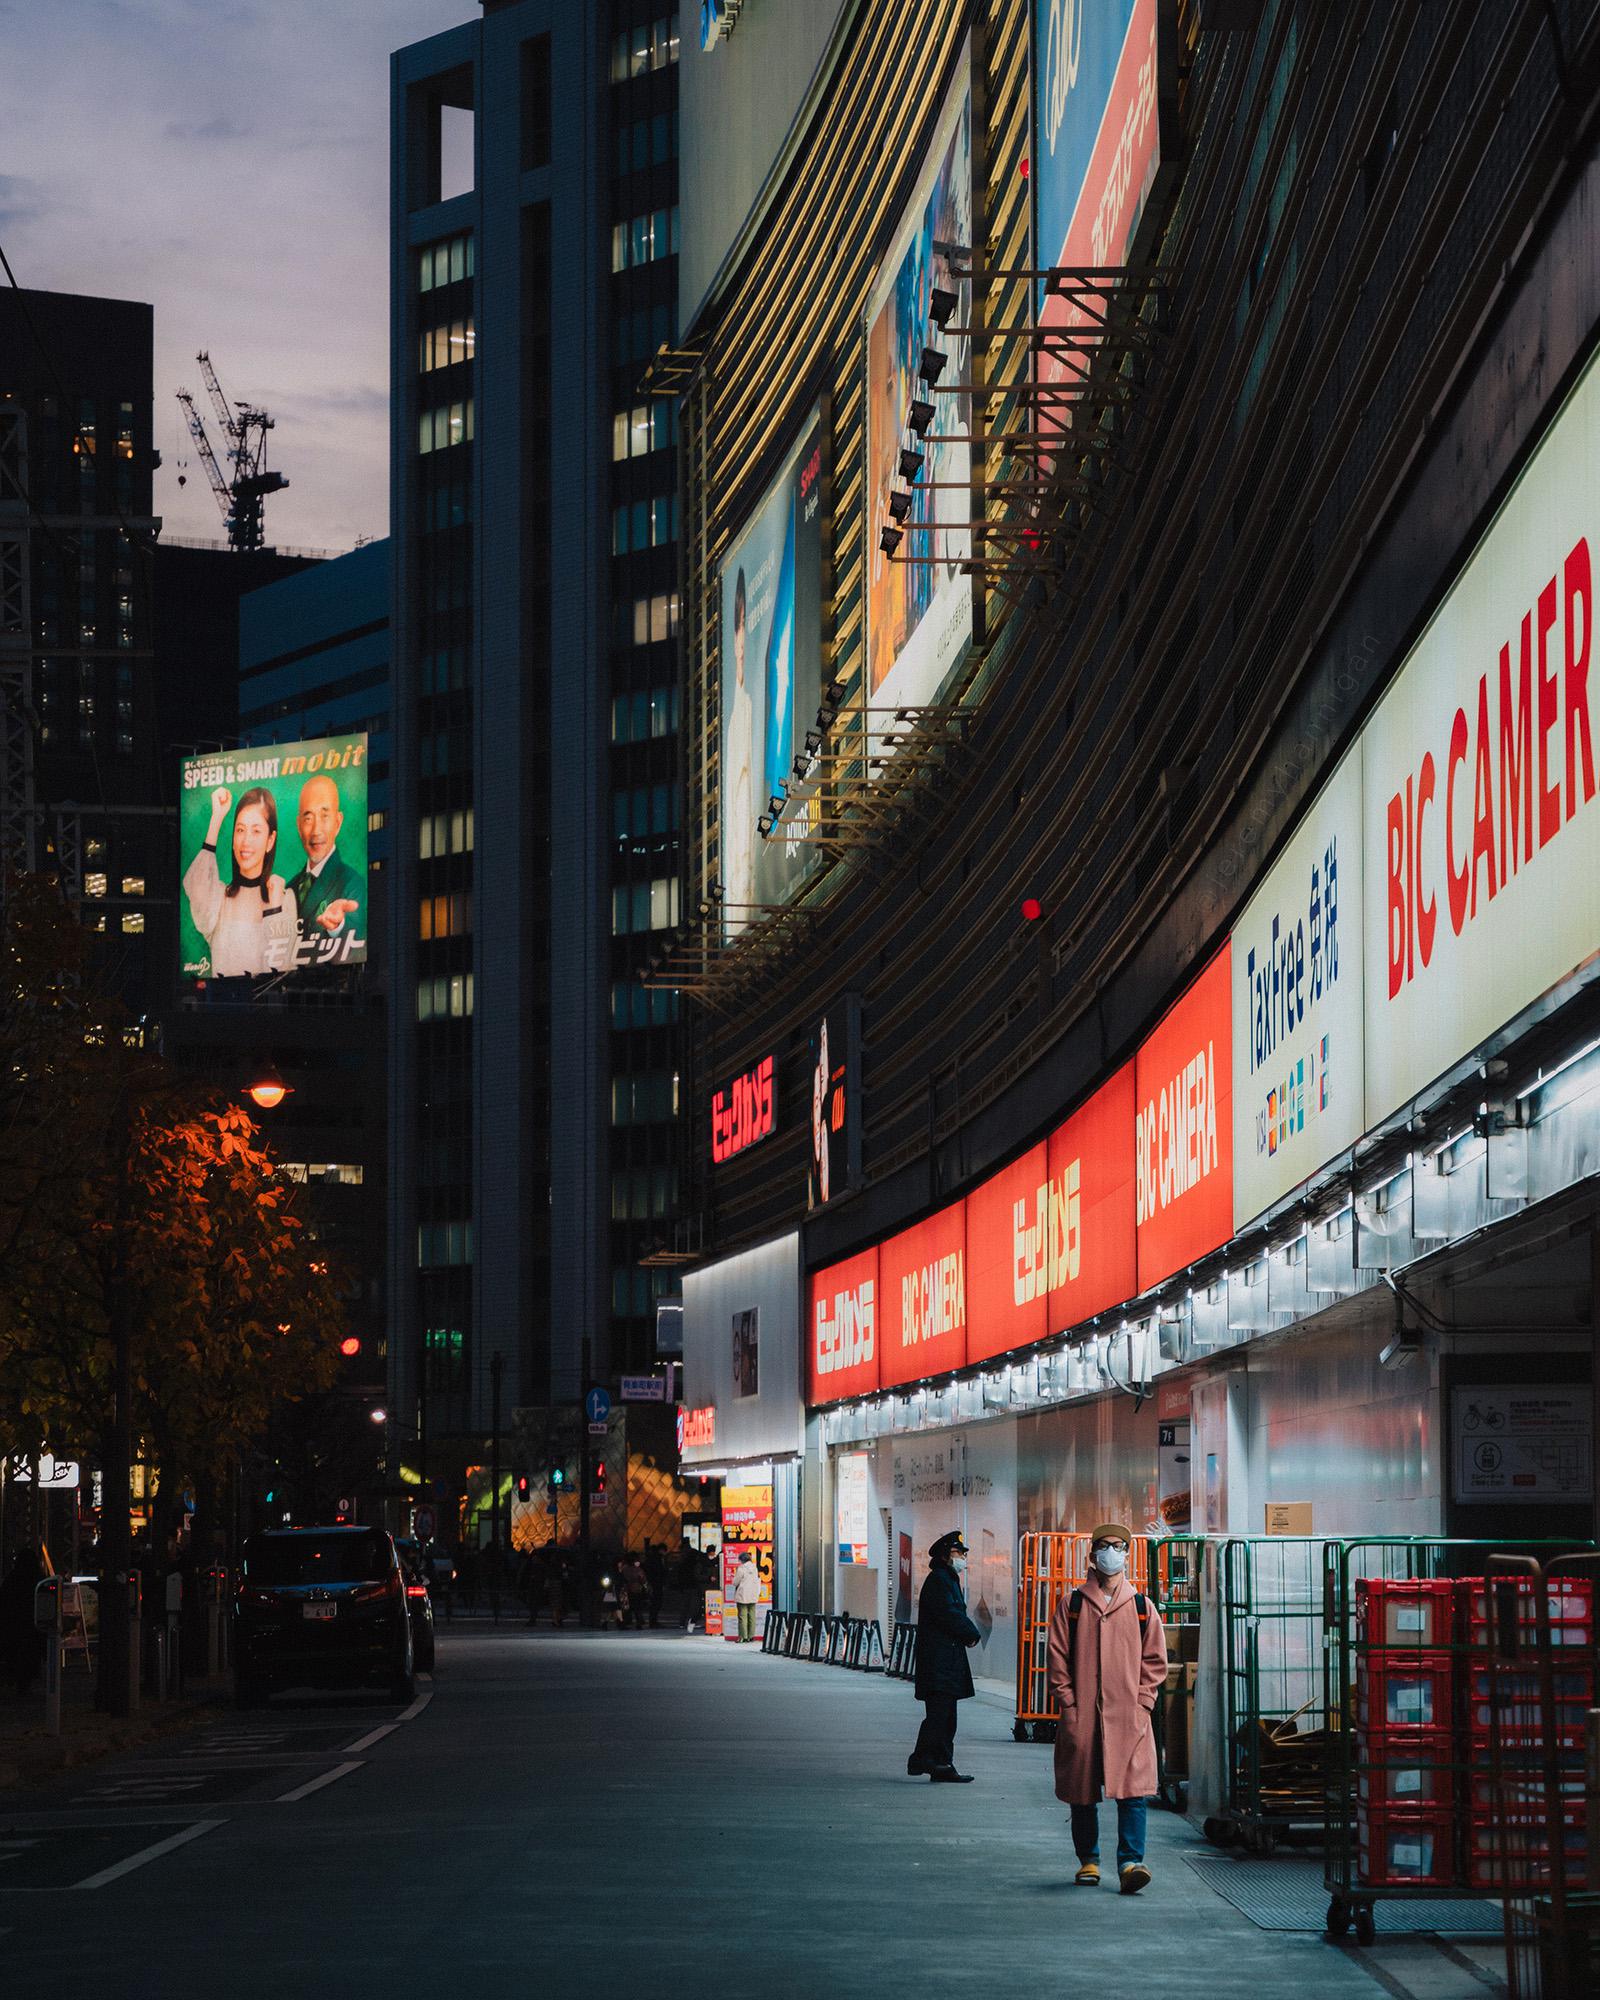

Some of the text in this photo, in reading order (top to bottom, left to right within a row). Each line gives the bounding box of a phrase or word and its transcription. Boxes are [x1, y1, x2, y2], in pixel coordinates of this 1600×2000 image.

[184, 758, 280, 789] SPEED & SMART
[281, 744, 365, 775] mobit
[1388, 536, 1600, 1000] BIC CAMER
[264, 929, 365, 968] モビット
[1248, 834, 1338, 1075] TaxFree 免税
[712, 1056, 773, 1163] ビックカメラ
[1136, 1040, 1218, 1227] BIC CAMERA
[1013, 1158, 1080, 1306] ビックカメラ
[816, 1279, 874, 1375] ビックカメラ
[902, 1249, 965, 1347] BIC CAMERA
